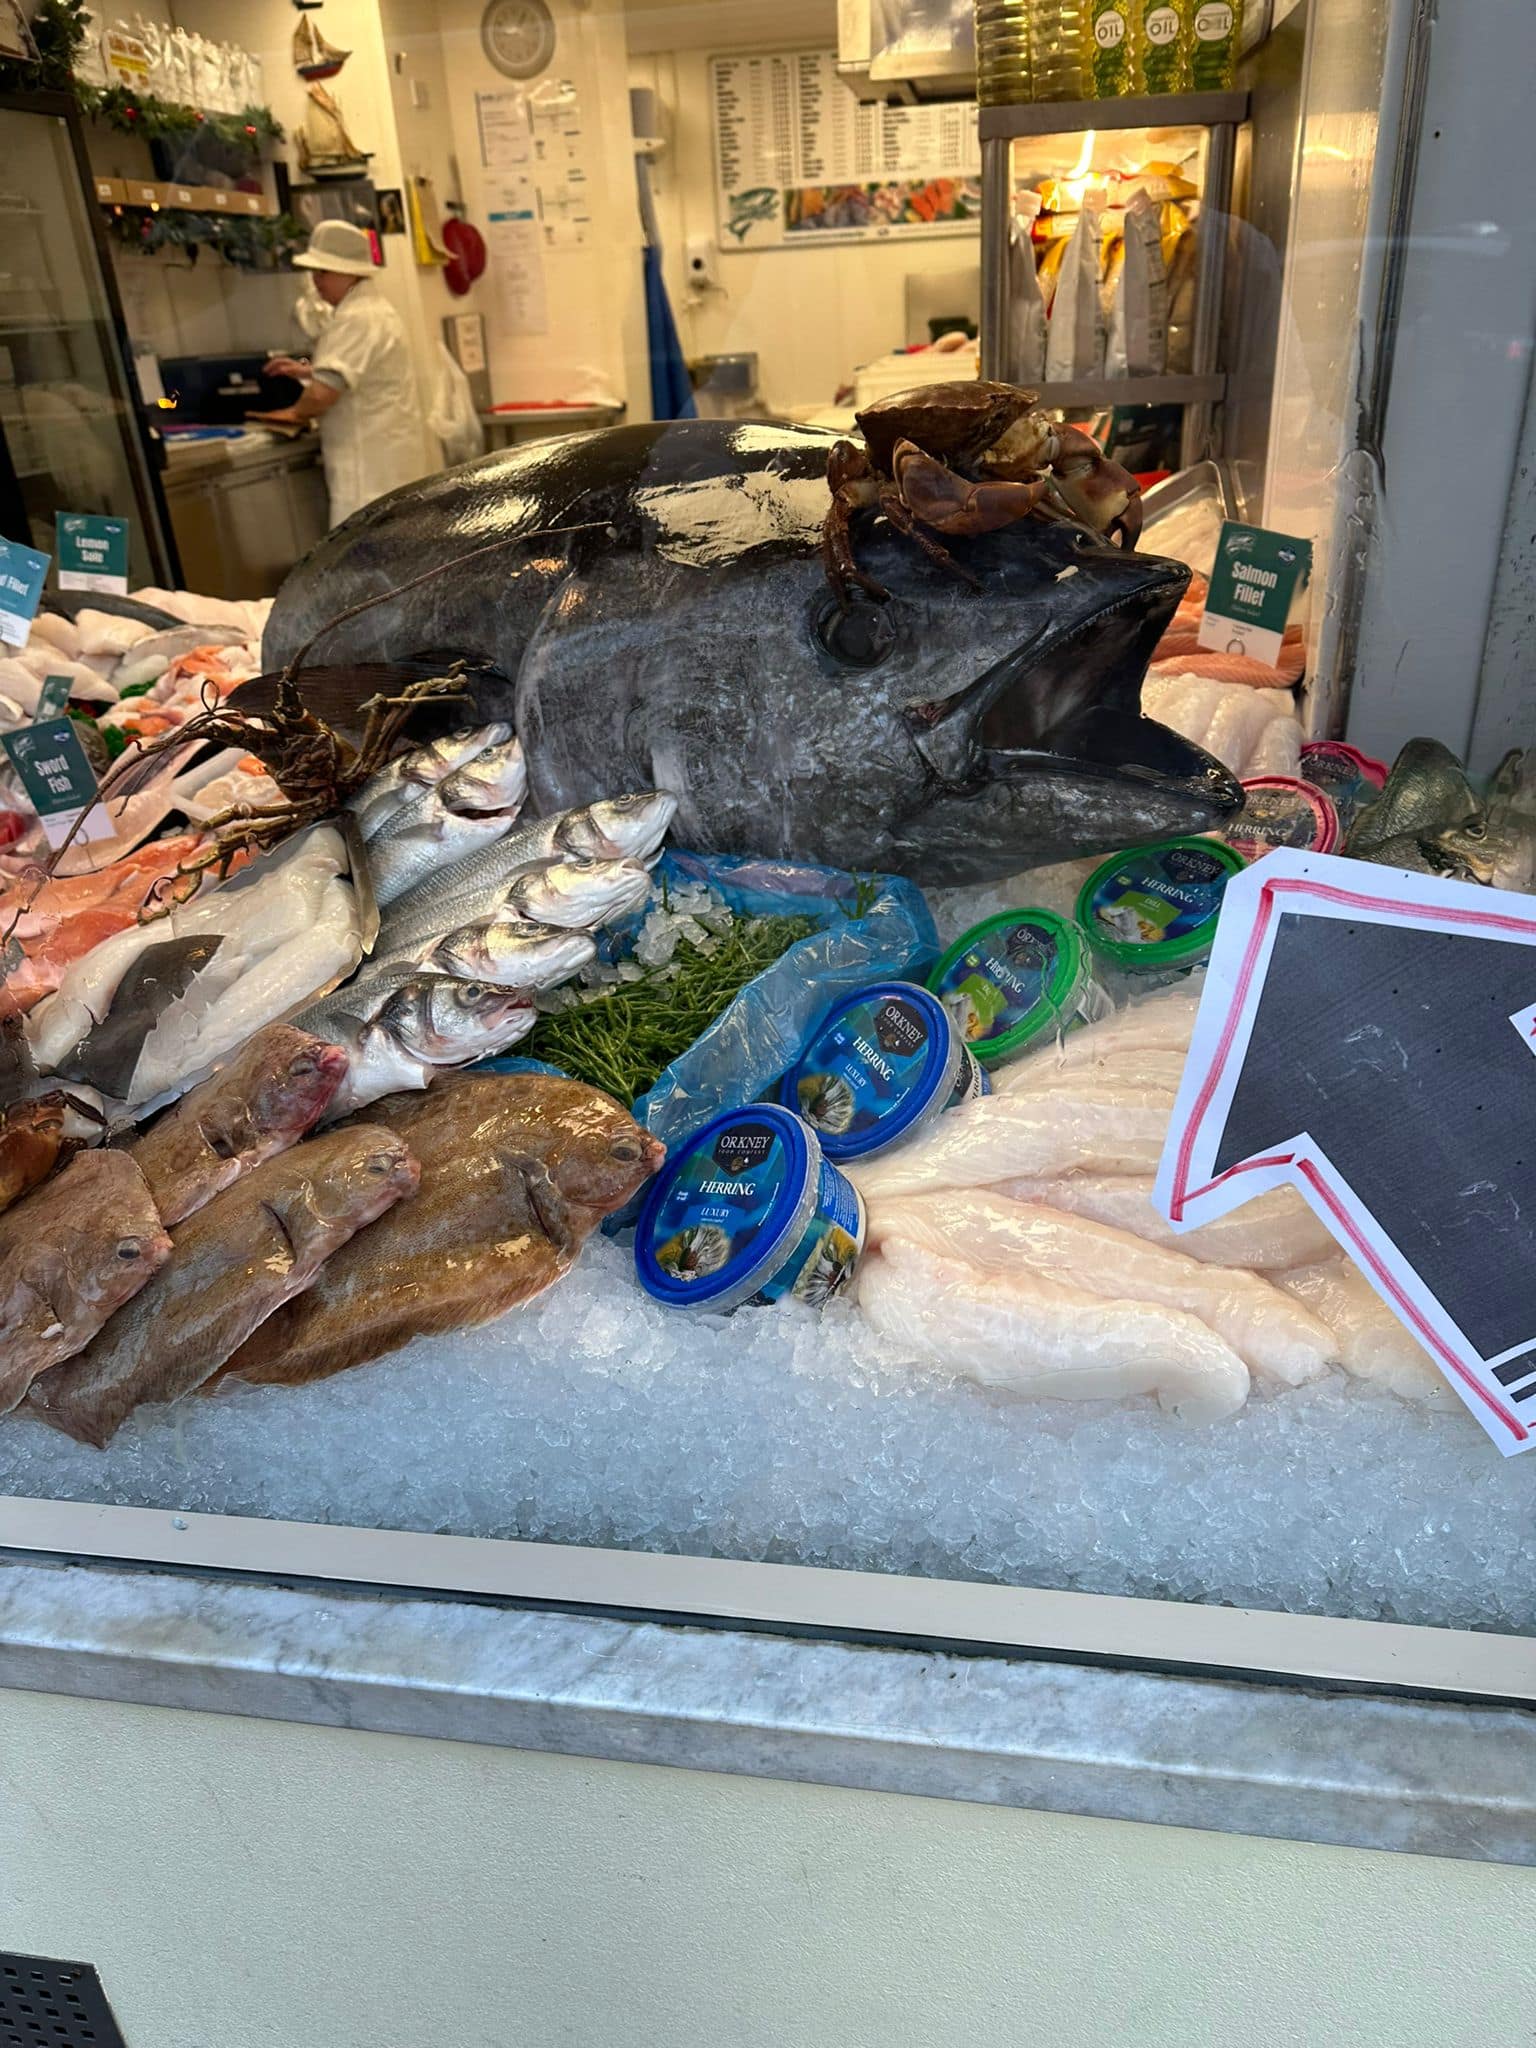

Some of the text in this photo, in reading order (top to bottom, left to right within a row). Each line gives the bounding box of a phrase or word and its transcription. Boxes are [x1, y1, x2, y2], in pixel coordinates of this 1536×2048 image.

[1097, 23, 1120, 40] OIL
[1150, 20, 1175, 36] OIL
[75, 536, 109, 552] Lemon
[1231, 560, 1278, 588] Salmon
[1233, 584, 1266, 607] Fillet
[34, 754, 70, 776] Sword
[47, 774, 73, 794] Fish
[1228, 822, 1288, 837] HERRING
[1171, 852, 1220, 876] ORKNEY
[1141, 876, 1194, 904] HERRING
[885, 1005, 924, 1043] ORKNEY
[852, 1035, 895, 1082] HERRING
[844, 1063, 867, 1087] LUXURY
[720, 1135, 770, 1149] ORKNEY
[699, 1180, 756, 1196] HERRING
[700, 1207, 729, 1218] LUXURY
